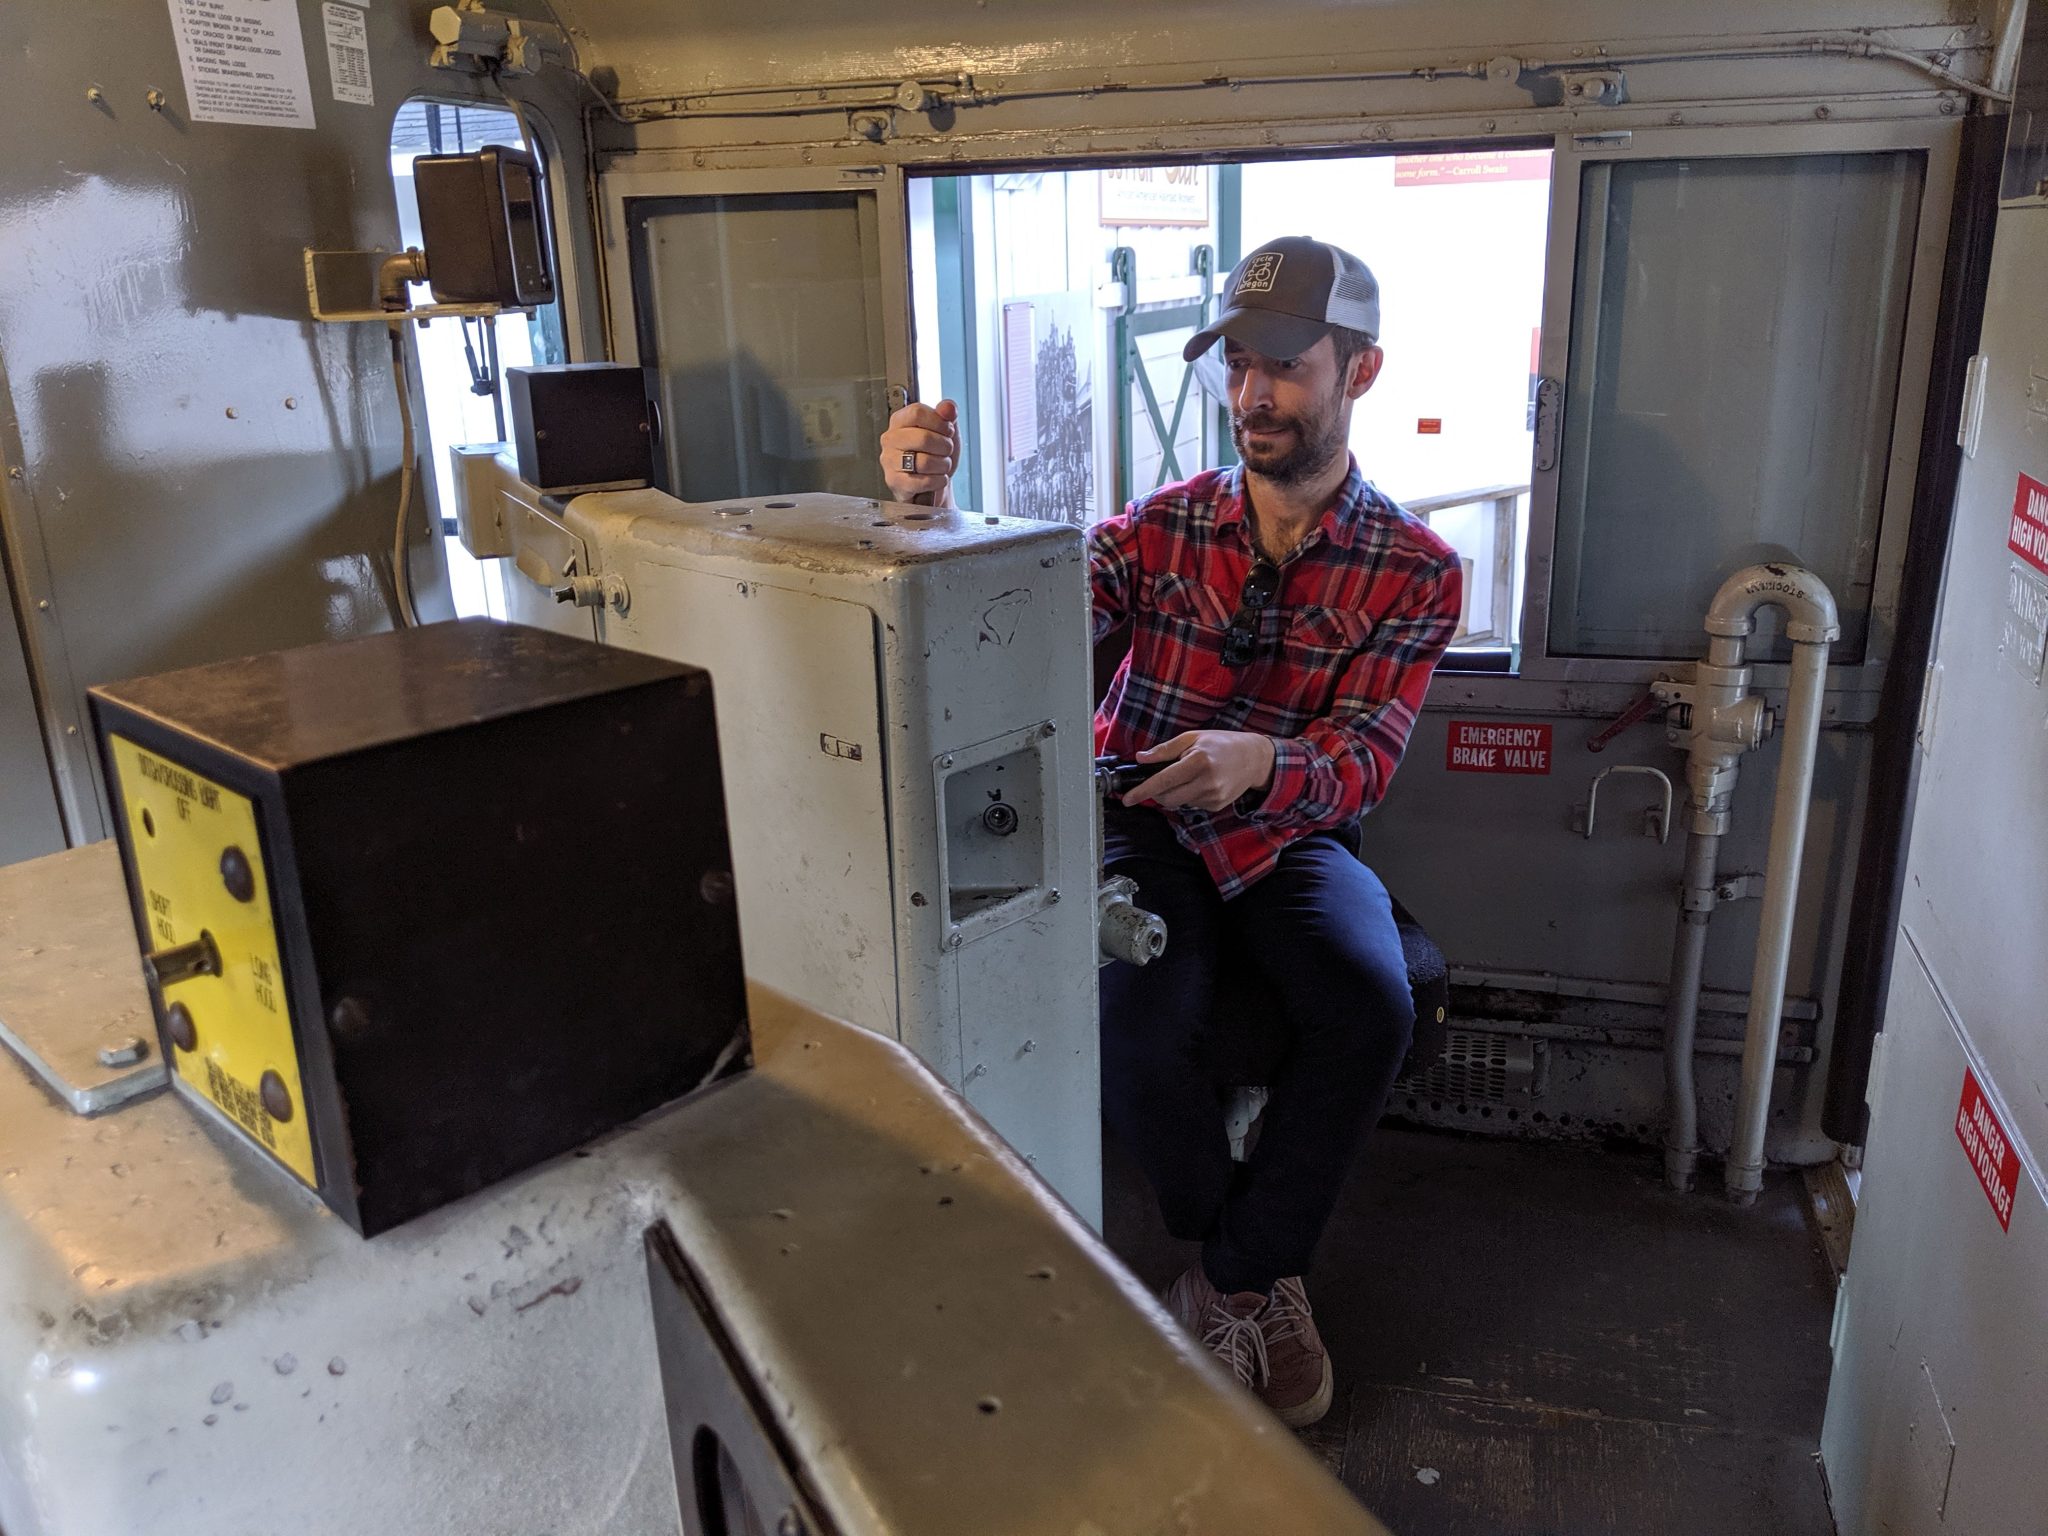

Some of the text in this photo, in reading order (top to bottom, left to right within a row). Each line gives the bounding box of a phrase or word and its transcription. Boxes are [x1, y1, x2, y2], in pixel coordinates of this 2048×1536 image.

[1252, 255, 1274, 264] cycle
[1239, 281, 1268, 290] oregon
[2011, 515, 2034, 554] HIGH
[1460, 726, 1542, 747] EMERGENCY
[1453, 746, 1547, 769] BRAKE VALVE
[1973, 1095, 2006, 1170] DANGER
[1958, 1105, 2011, 1222] HIGH VOLTAGE
